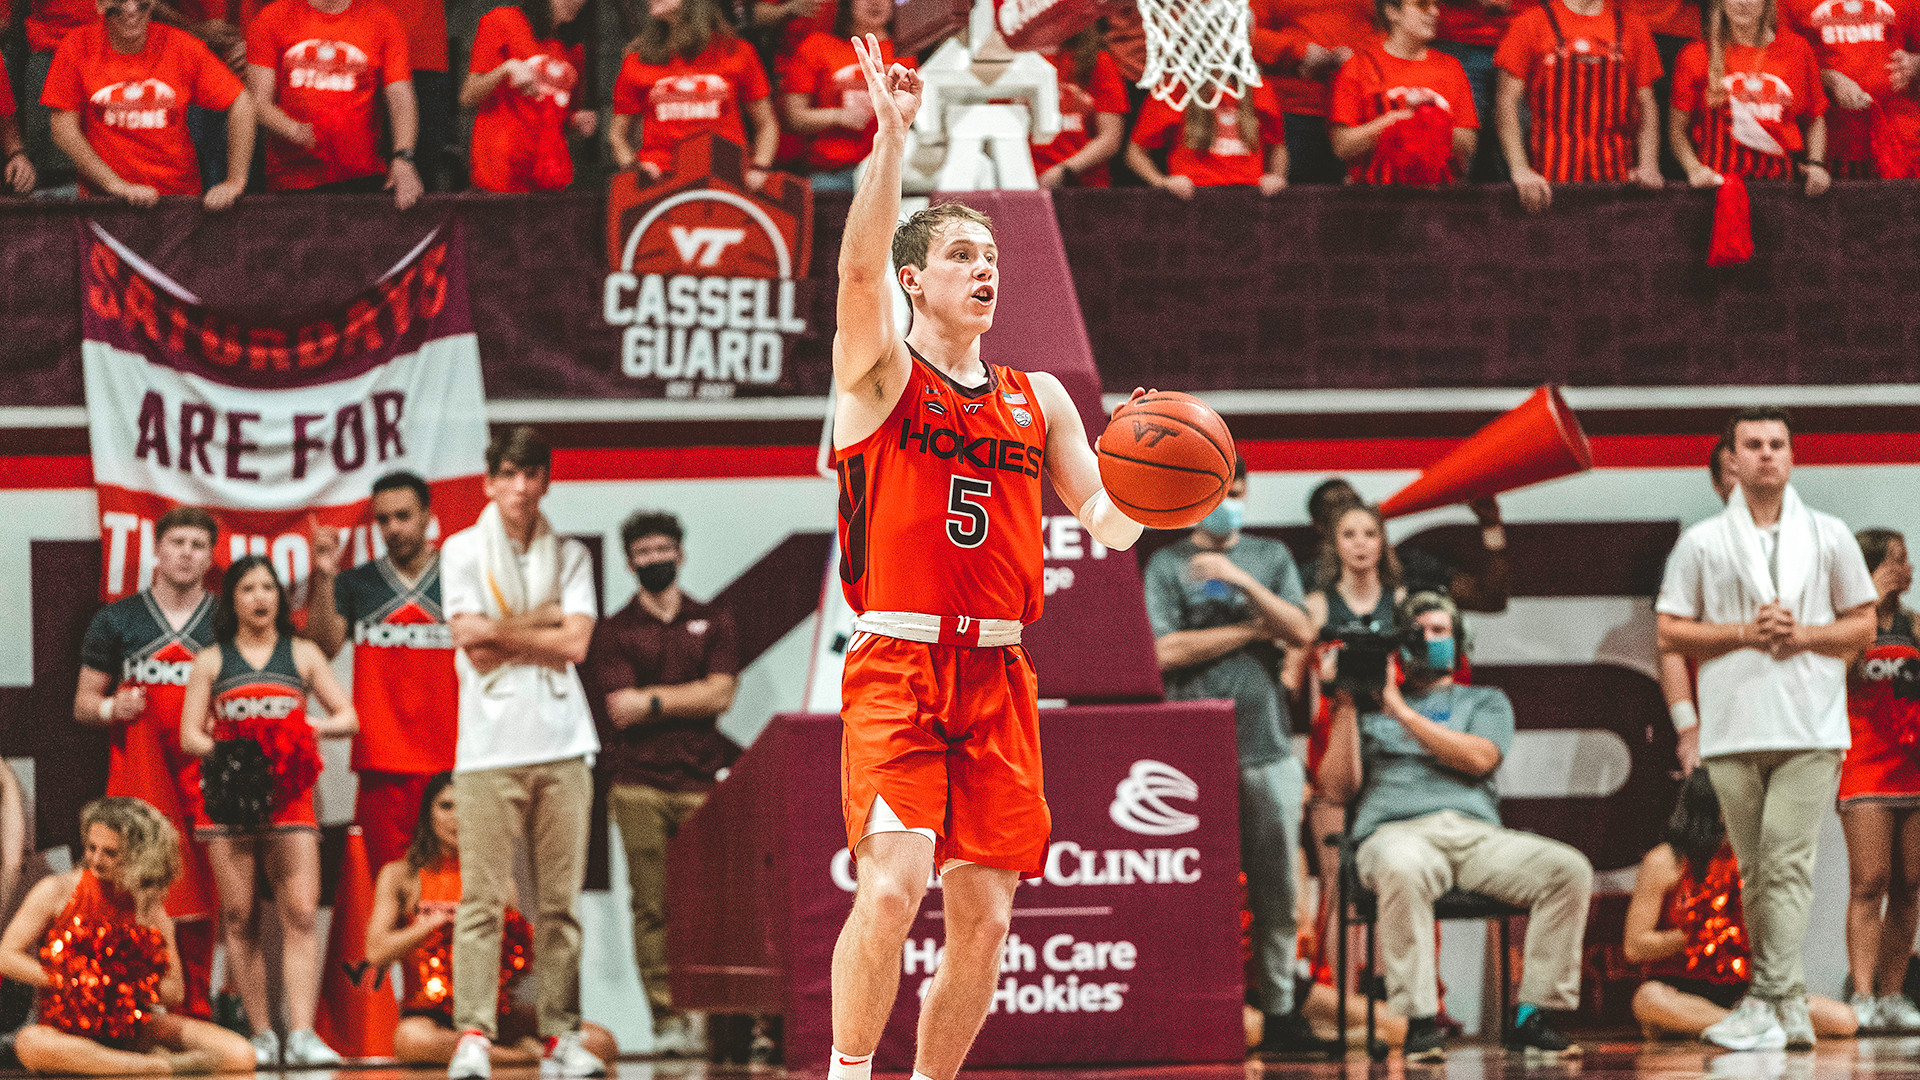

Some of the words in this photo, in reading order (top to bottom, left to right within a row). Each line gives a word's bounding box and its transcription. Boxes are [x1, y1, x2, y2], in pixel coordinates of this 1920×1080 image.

[1821, 23, 1884, 44] STONE
[289, 68, 356, 91] STONE
[670, 226, 744, 267] VT
[603, 271, 806, 332] CASSELL
[621, 325, 783, 384] GUARD
[962, 402, 984, 415] VT
[136, 390, 261, 481] ARE
[293, 391, 406, 478] FOR
[901, 419, 1043, 479] HOKIES
[1133, 421, 1180, 448] VT
[945, 474, 992, 549] 5
[1045, 840, 1201, 887] CLINIC
[1043, 933, 1138, 971] Care
